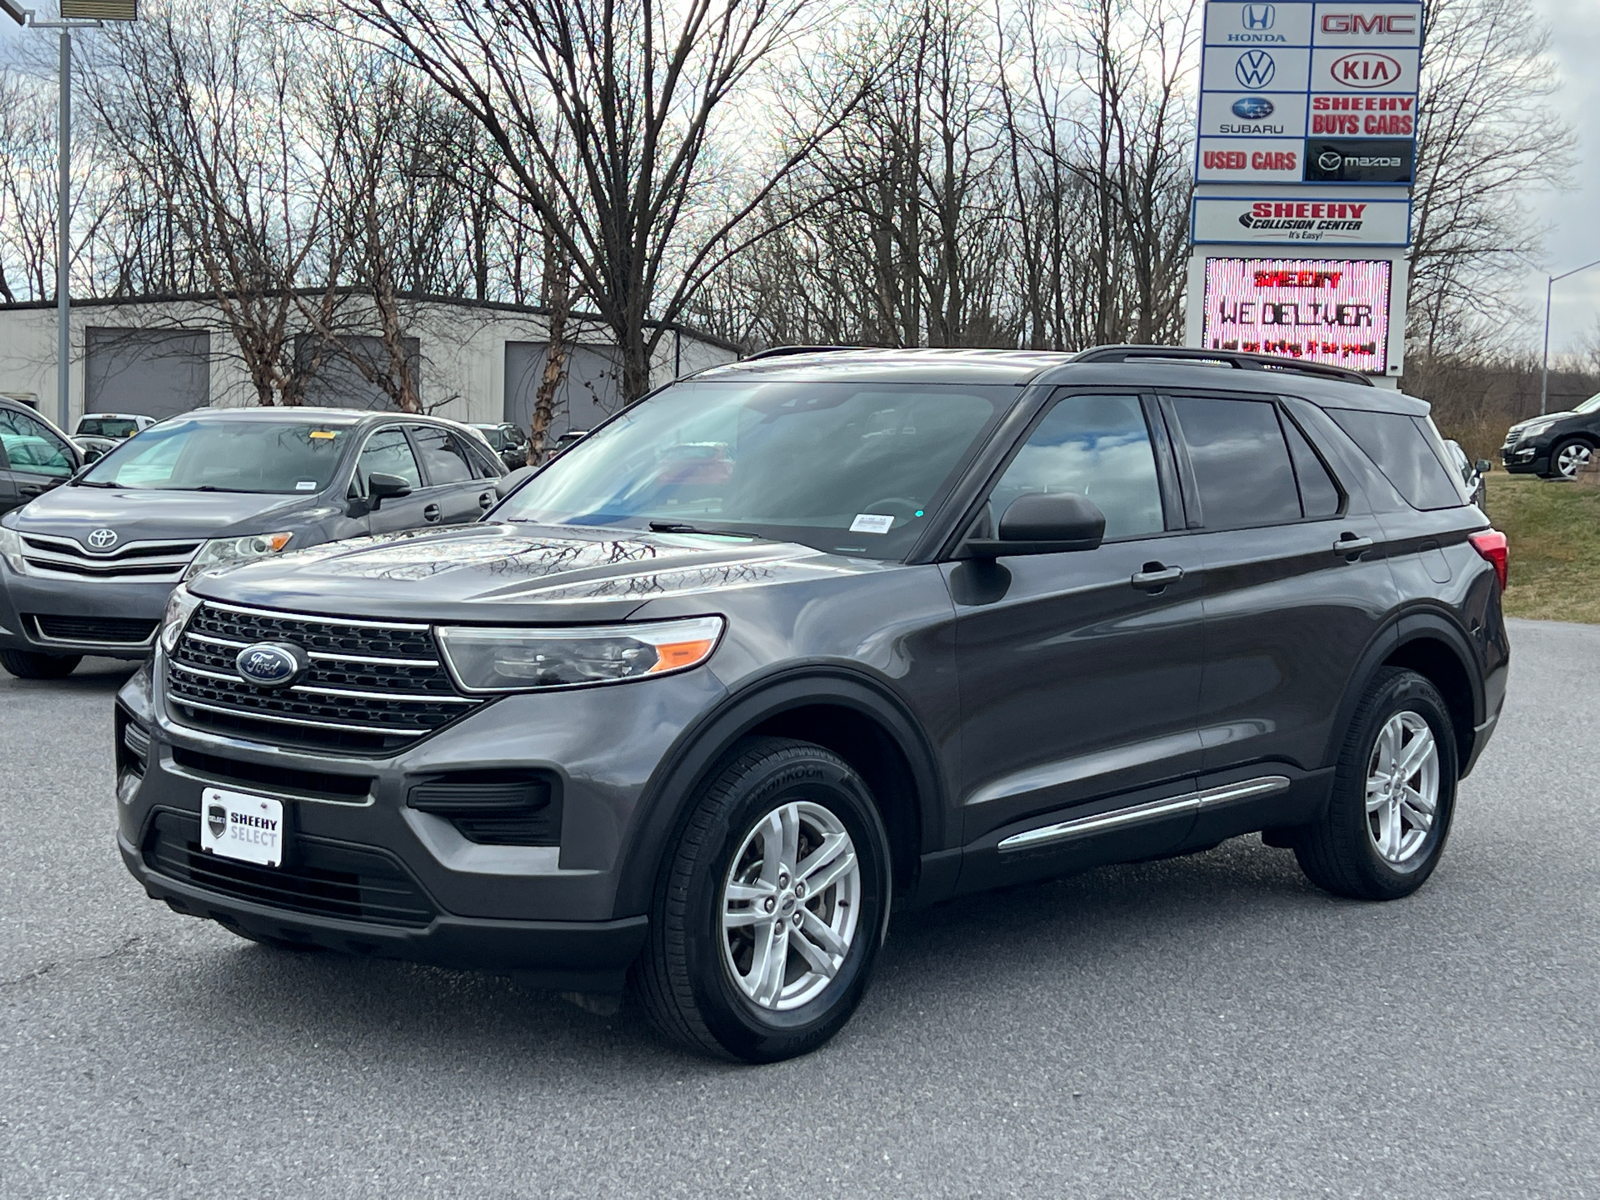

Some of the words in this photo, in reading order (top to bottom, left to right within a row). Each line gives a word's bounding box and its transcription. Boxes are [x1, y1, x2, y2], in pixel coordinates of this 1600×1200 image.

[1321, 14, 1415, 35] GMC
[1227, 33, 1287, 42] HONDA
[1343, 60, 1389, 80] KIA
[1312, 97, 1414, 111] SHEEHY
[1219, 124, 1284, 134] SUBARU
[1312, 114, 1359, 135] BUYS
[1364, 115, 1413, 135] CARS
[1203, 151, 1247, 170] USED
[1251, 151, 1297, 171] CARS
[1344, 156, 1402, 167] mazda
[1252, 202, 1367, 219] SHEEHY
[1251, 219, 1316, 230] COLLISION
[1316, 220, 1363, 231] CENTER
[1288, 230, 1301, 240] It's
[1302, 231, 1323, 241] Easy!
[1220, 301, 1256, 325] WE
[1262, 302, 1373, 327] DELIVER
[247, 651, 281, 676] Ford
[230, 811, 277, 831] SHEEHY
[230, 825, 277, 848] SELECT
